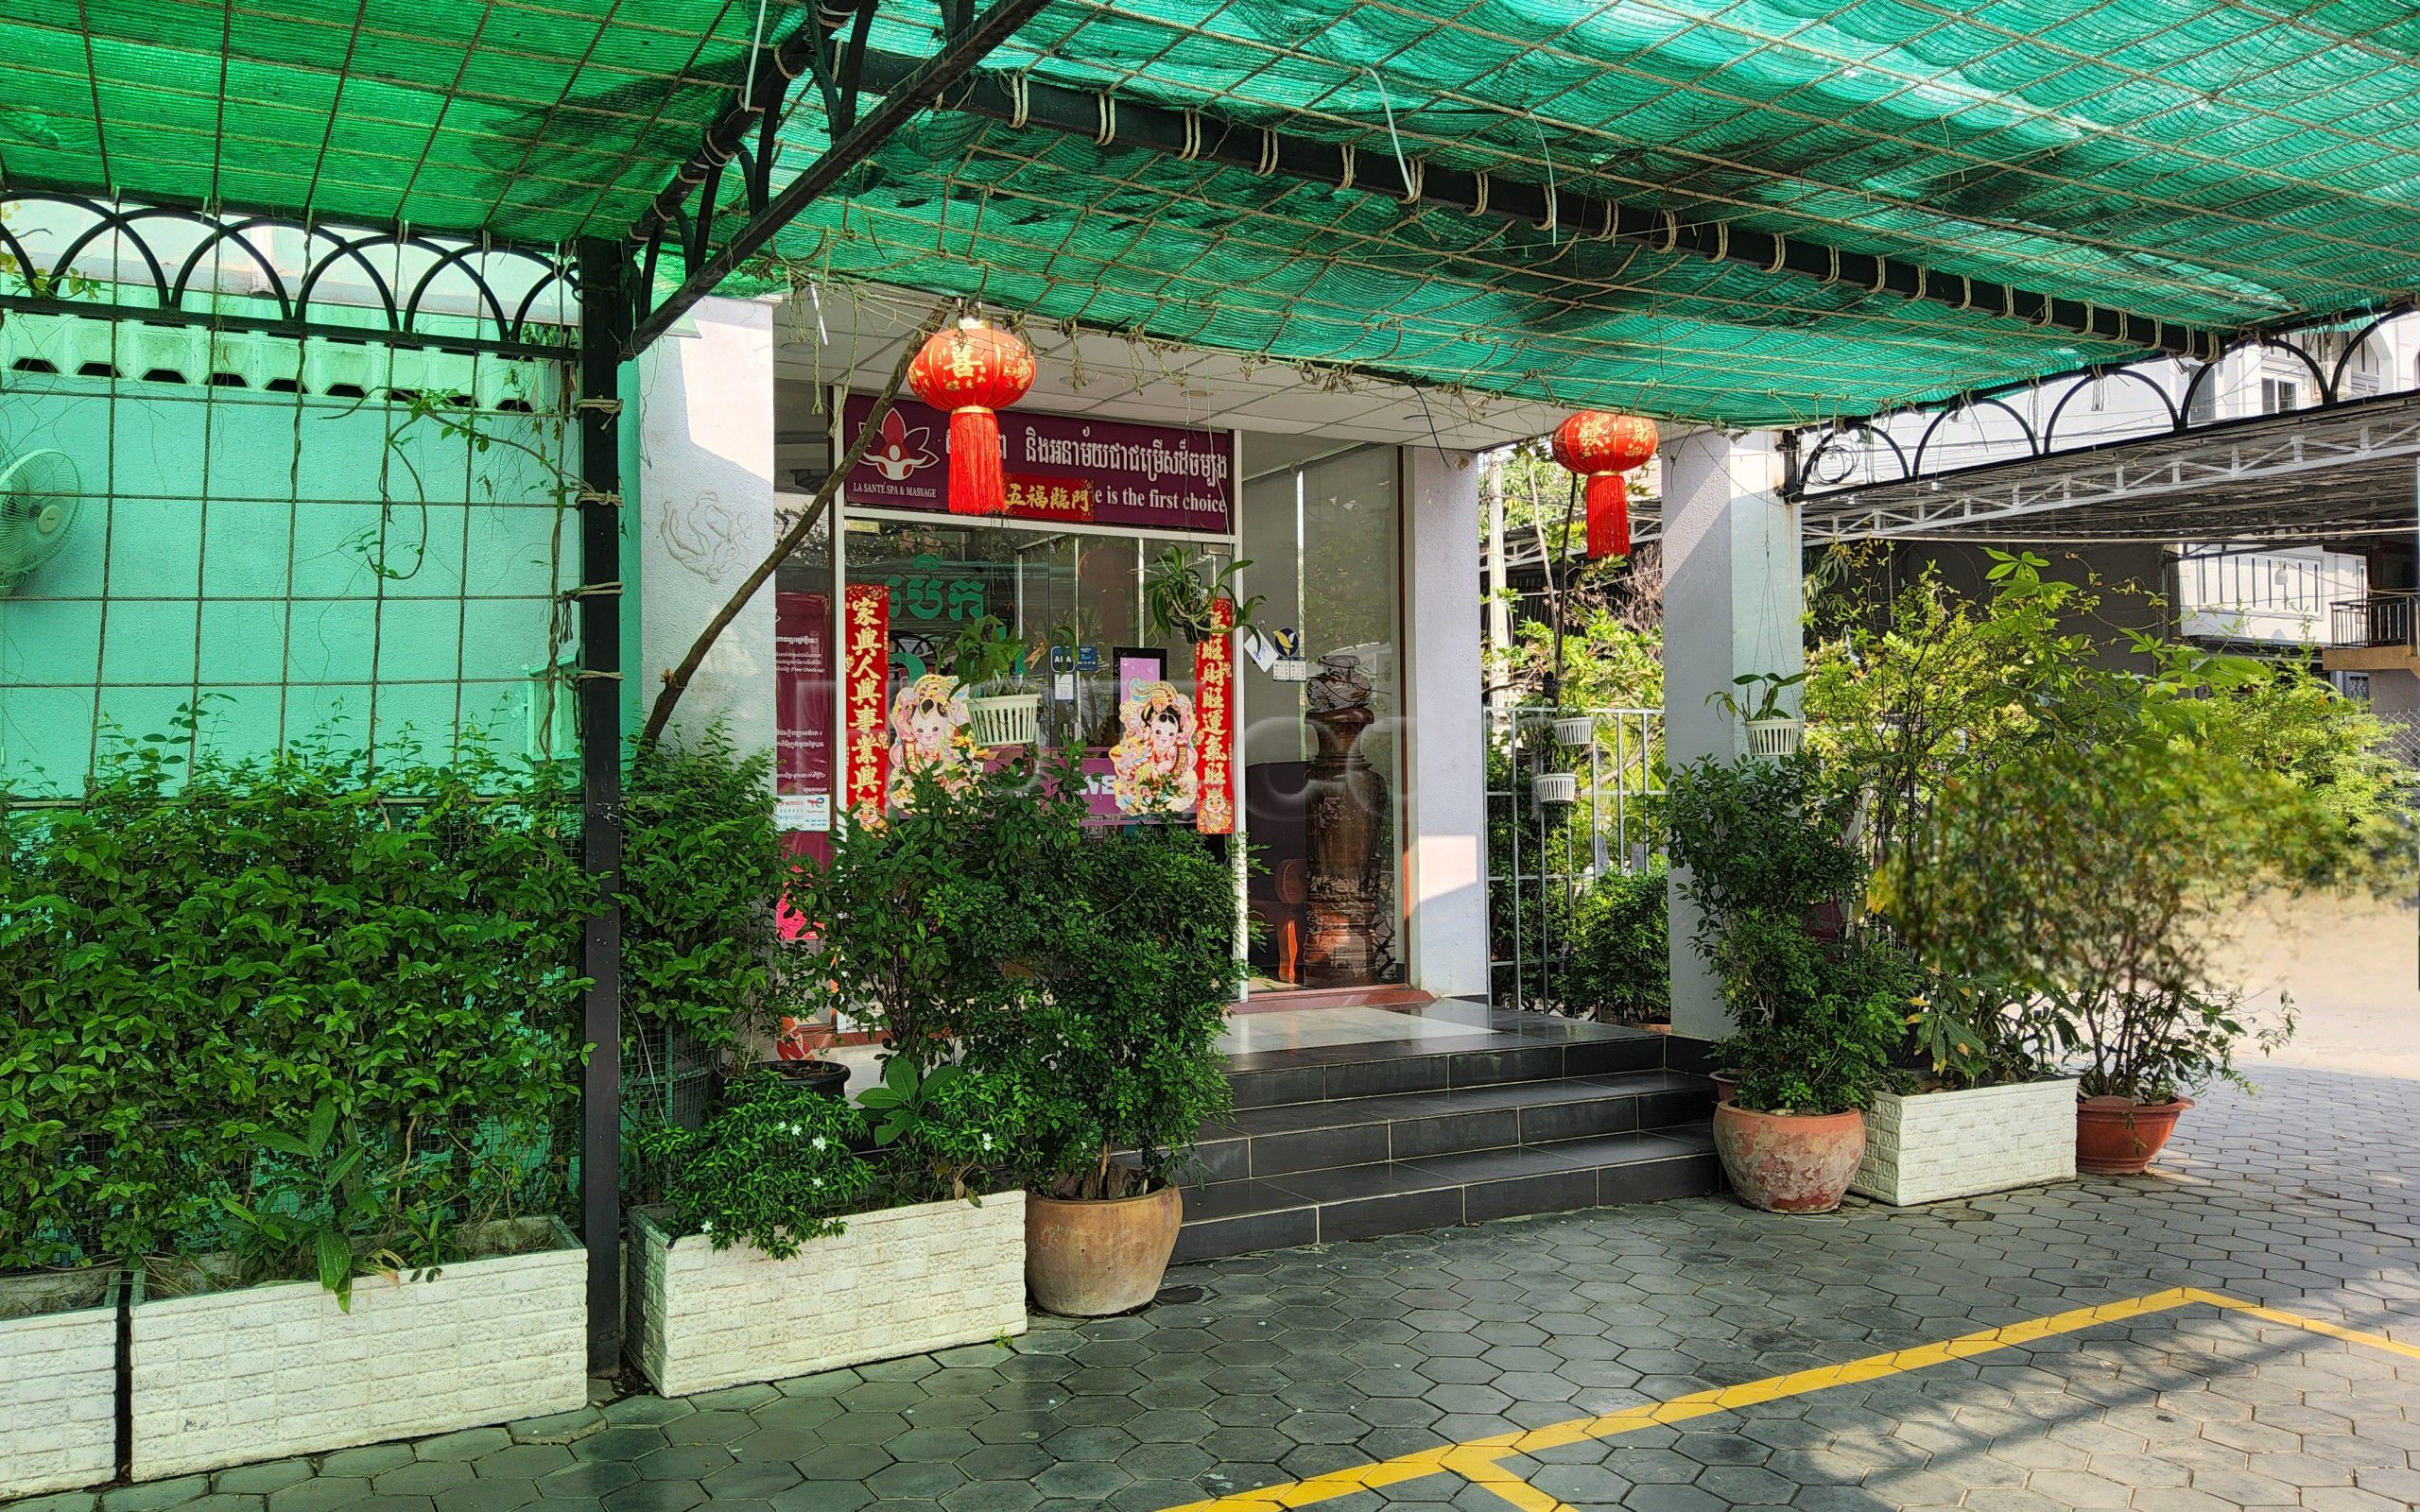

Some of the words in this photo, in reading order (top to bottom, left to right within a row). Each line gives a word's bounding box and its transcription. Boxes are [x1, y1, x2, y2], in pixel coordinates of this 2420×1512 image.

[854, 482, 862, 492] LA
[887, 485, 898, 495] SPA
[899, 486, 905, 496] &
[906, 487, 937, 498] MASSAGE
[1006, 483, 1089, 512] 五福臨門
[1107, 485, 1117, 505] is
[1122, 487, 1145, 507] the
[1149, 489, 1179, 509] first
[1183, 491, 1226, 513] choice
[850, 596, 883, 793] 家興人興事業興
